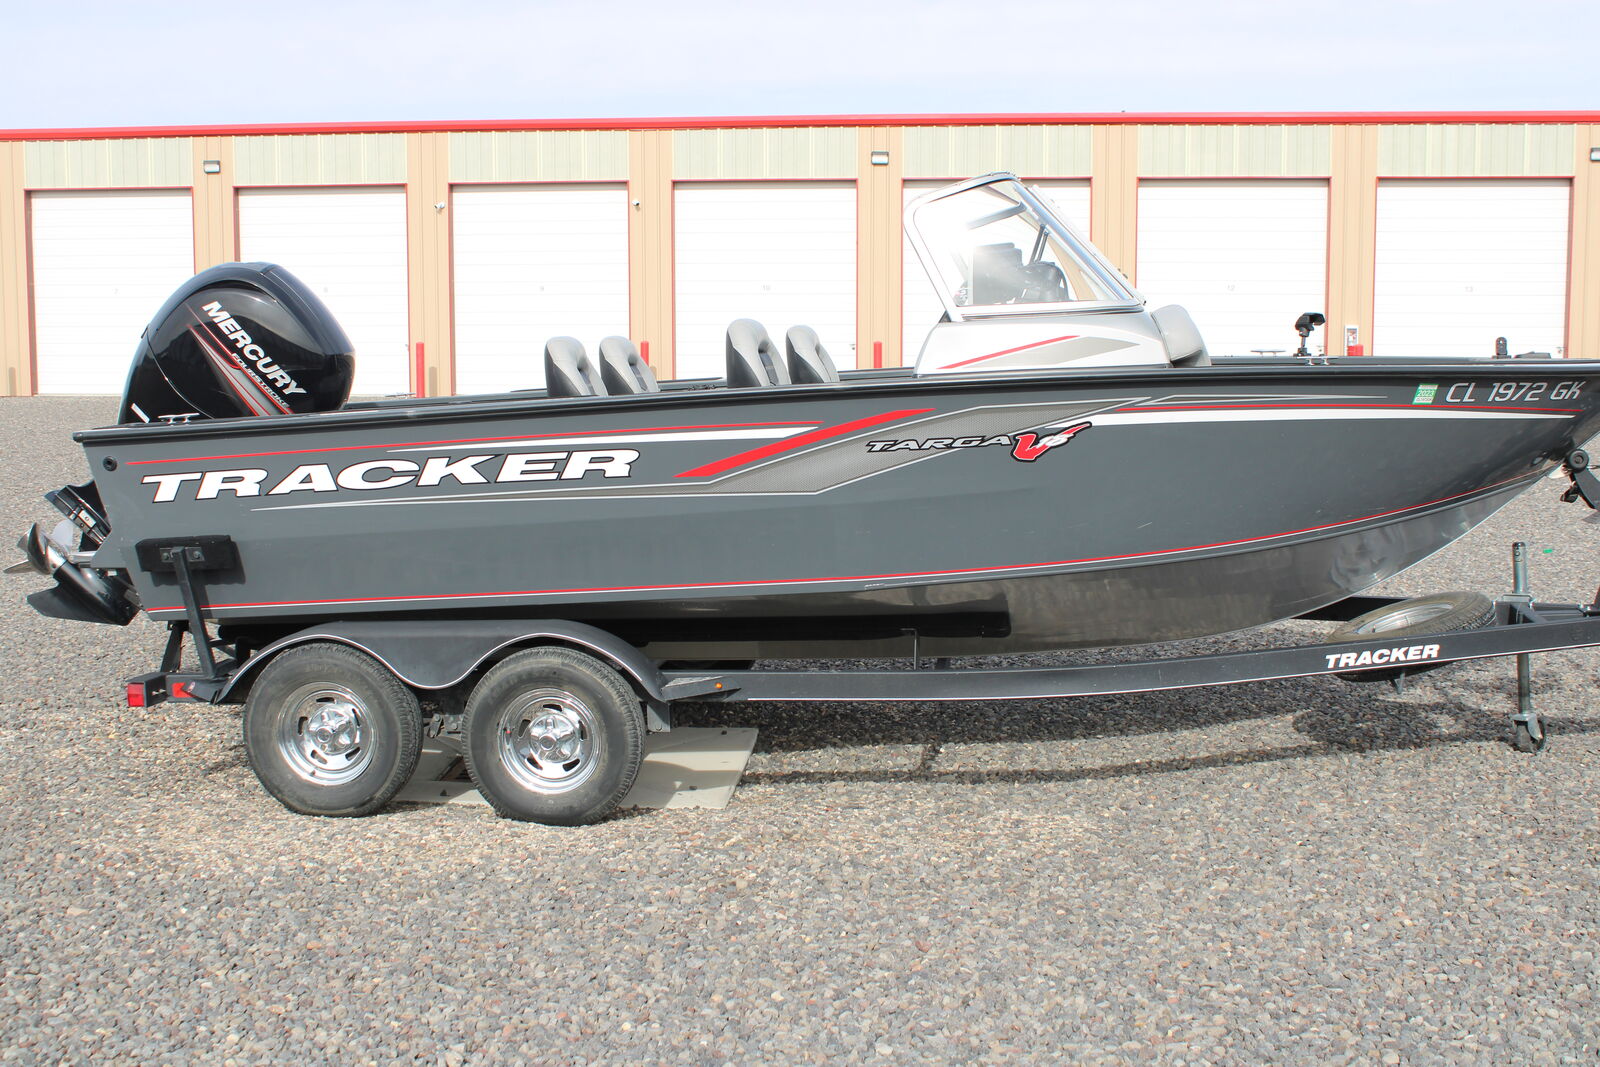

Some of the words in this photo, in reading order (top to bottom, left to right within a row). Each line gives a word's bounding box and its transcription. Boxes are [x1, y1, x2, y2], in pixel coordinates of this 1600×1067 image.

[202, 301, 307, 395] MERCURY
[1416, 389, 1435, 397] 2023
[1445, 382, 1476, 403] CL
[1487, 382, 1548, 402] 1972
[1550, 380, 1587, 401] GK
[866, 434, 1013, 453] TARGA
[140, 448, 641, 504] TRACKER
[1325, 644, 1440, 668] TRACKER
